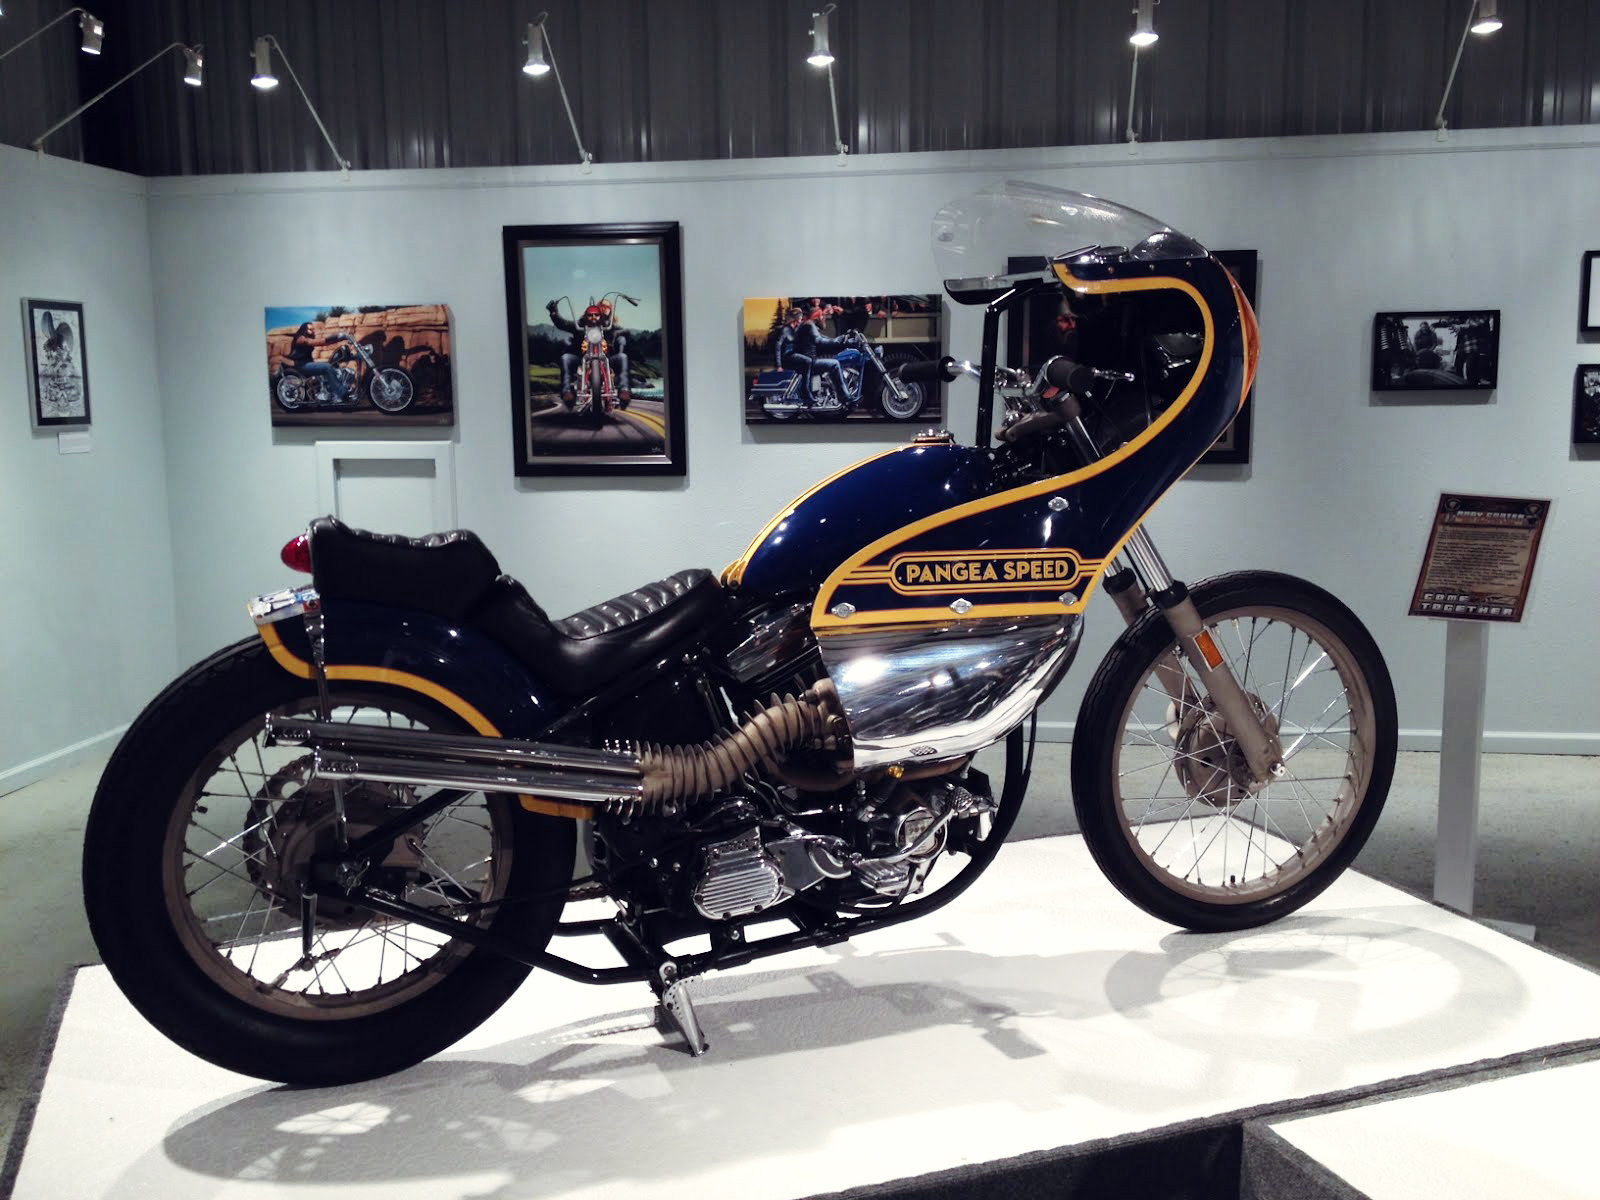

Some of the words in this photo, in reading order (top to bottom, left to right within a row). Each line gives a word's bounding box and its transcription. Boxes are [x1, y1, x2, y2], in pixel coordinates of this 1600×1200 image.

[906, 562, 998, 583] PANGEA
[1003, 560, 1069, 580] SPEED
[1424, 593, 1470, 602] COME
[1421, 602, 1513, 616] TOGETHER
